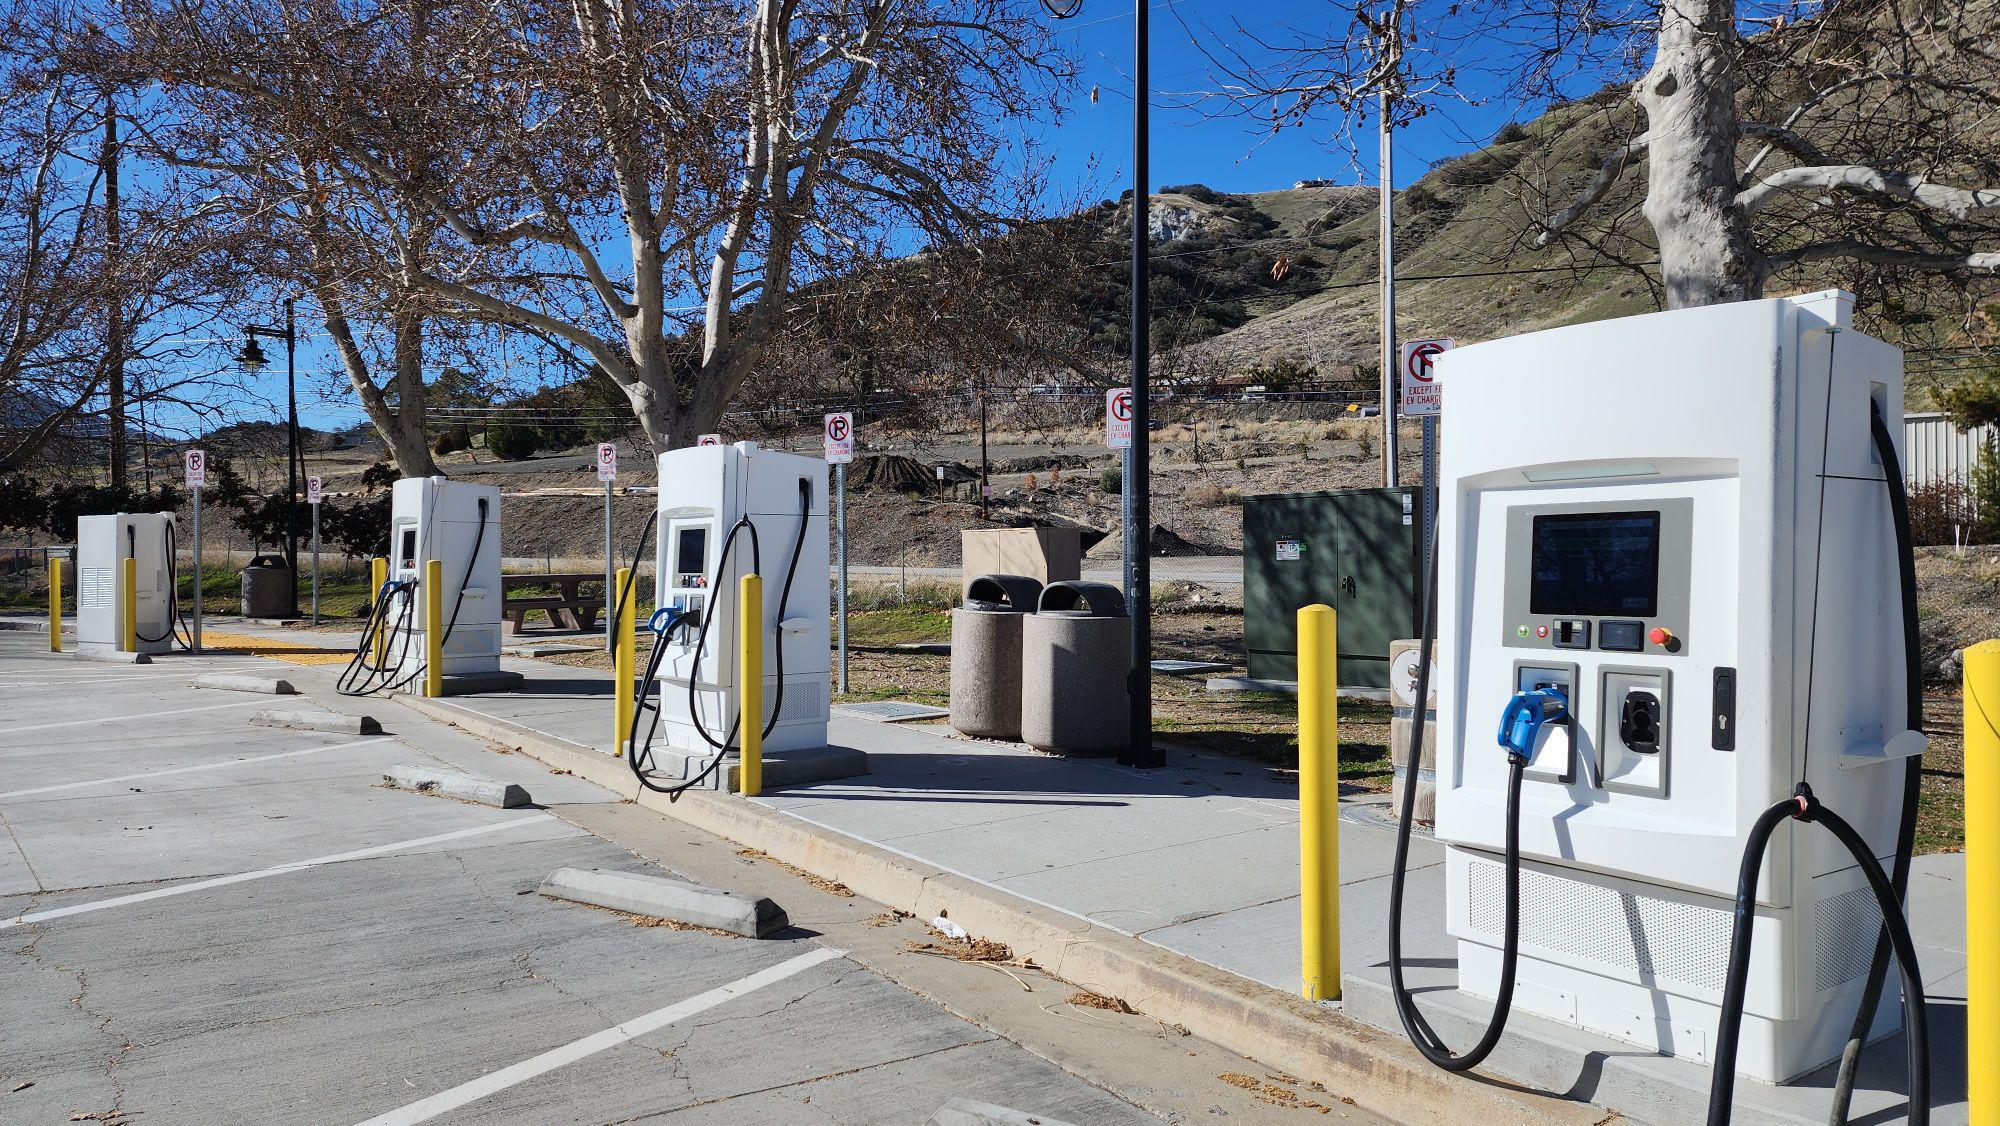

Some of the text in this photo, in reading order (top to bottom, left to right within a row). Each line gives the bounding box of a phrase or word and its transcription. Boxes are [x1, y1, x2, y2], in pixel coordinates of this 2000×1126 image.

[1409, 385, 1433, 395] EXCEPT
[1407, 395, 1441, 405] EV CHARGI
